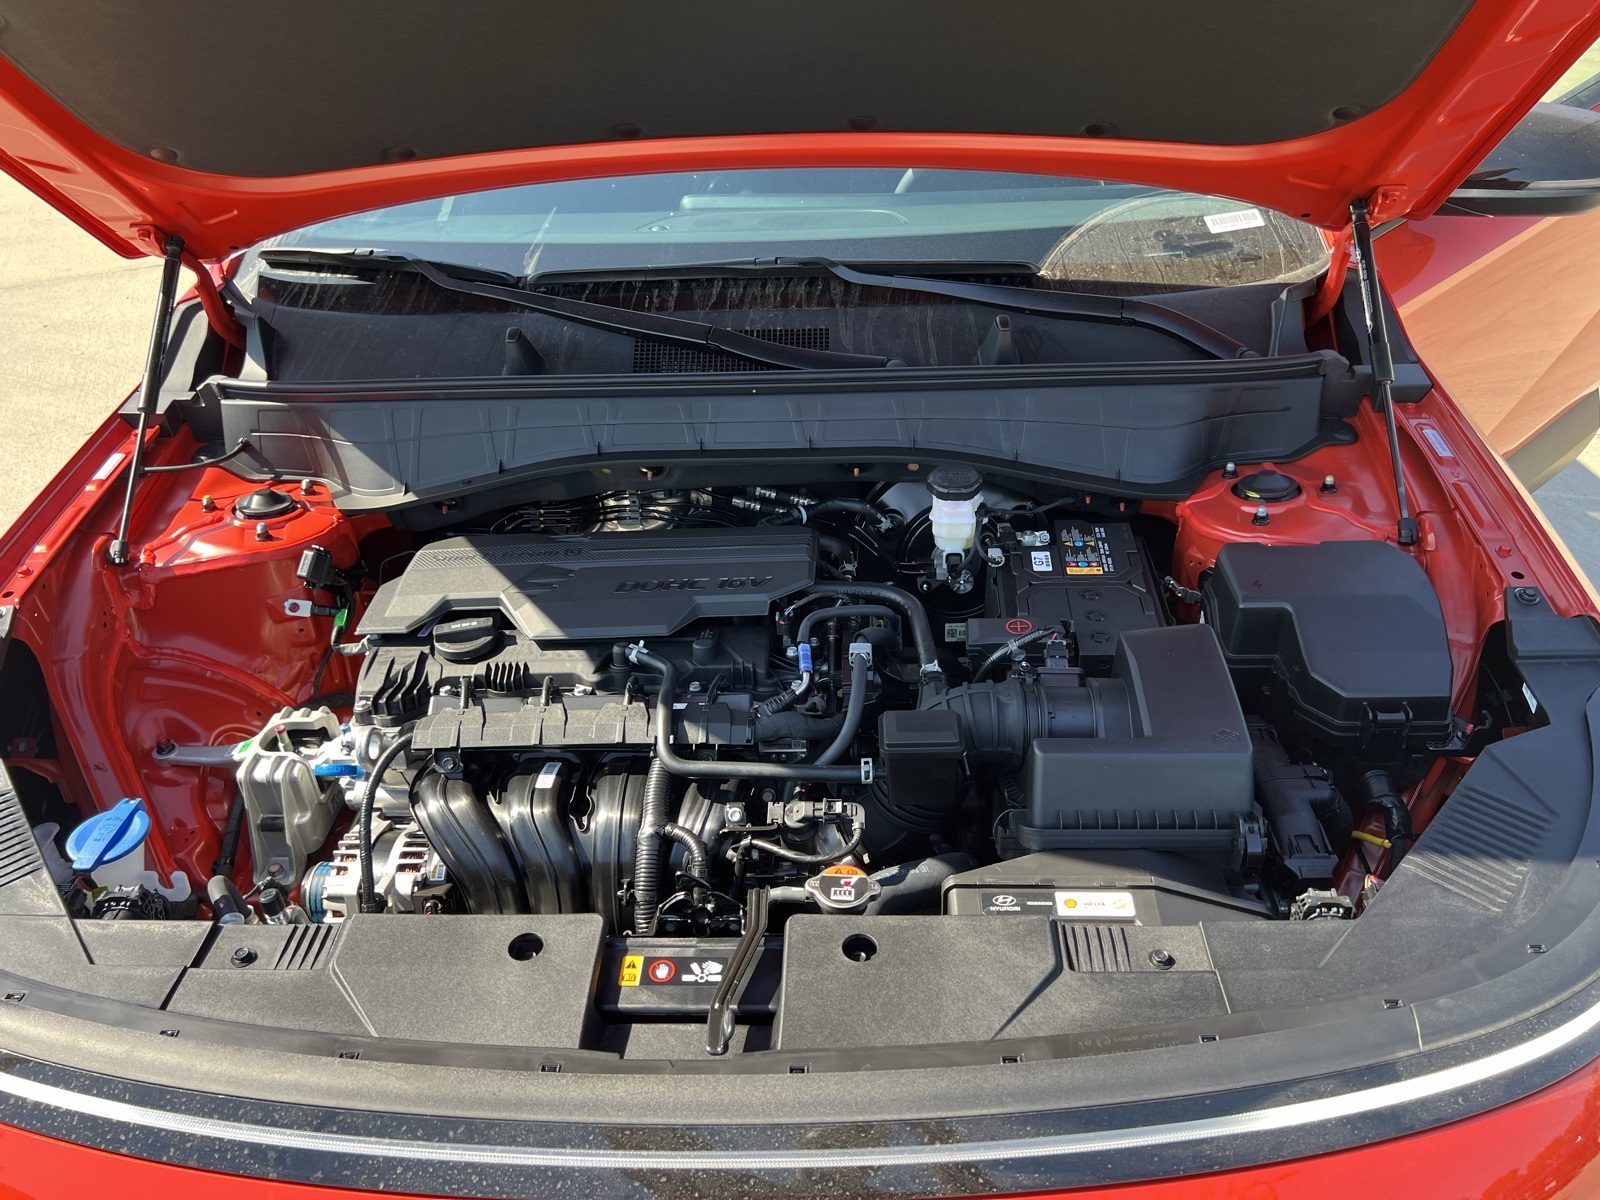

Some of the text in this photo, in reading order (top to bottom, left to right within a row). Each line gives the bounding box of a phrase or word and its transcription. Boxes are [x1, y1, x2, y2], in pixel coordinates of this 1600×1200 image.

[1033, 557, 1044, 566] G7
[614, 575, 773, 593] DOHC 16V
